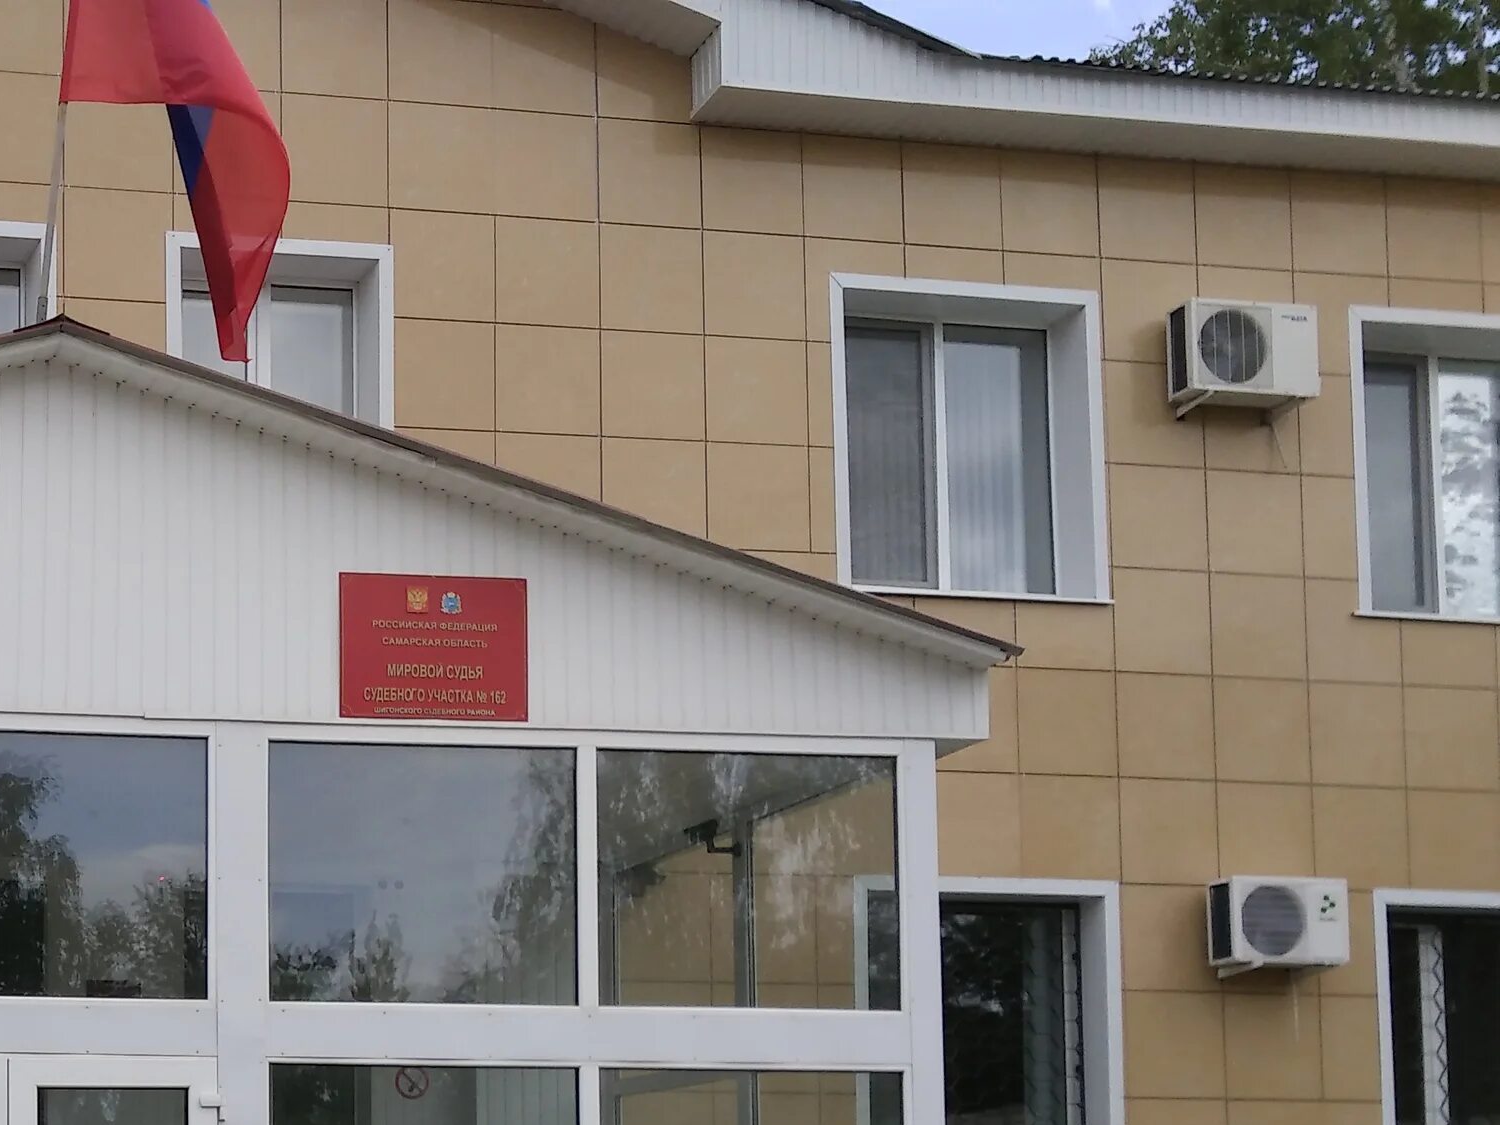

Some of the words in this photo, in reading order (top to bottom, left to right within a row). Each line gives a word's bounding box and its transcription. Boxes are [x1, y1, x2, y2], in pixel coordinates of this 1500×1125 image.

[440, 622, 498, 632] ФЕДЕРАЦИЯ
[382, 637, 441, 647] САМАРСКАЯ
[443, 638, 488, 648] ОБЛАСТЬ
[387, 662, 443, 678] МИРОВОЙ
[446, 665, 483, 681] СУДЬЯ
[363, 687, 426, 703] СУДЕБНОГО
[427, 689, 473, 704] УЧАСТКА
[476, 691, 487, 704] №
[490, 690, 507, 704] 162
